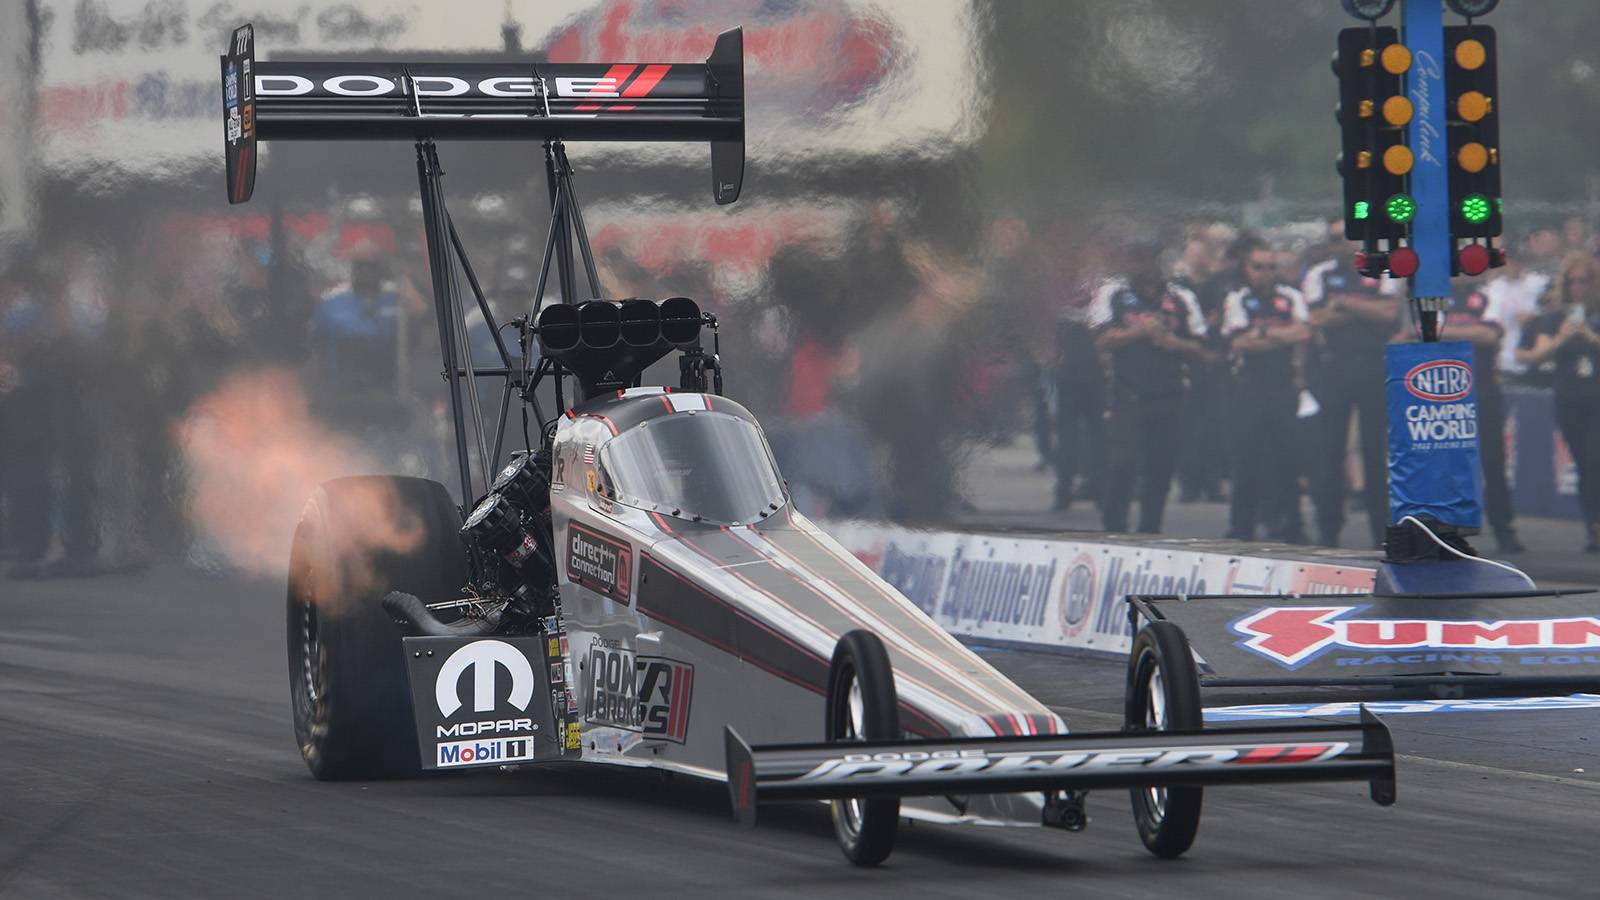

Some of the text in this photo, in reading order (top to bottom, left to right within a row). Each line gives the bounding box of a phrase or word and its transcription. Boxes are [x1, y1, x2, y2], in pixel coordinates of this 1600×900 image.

[255, 75, 619, 98] DODGE
[1416, 367, 1471, 394] NHRA
[1405, 403, 1475, 422] CAMPING
[1408, 420, 1477, 441] WORLD
[571, 555, 615, 585] connection
[1336, 653, 1503, 666] RACING
[437, 718, 533, 738] MOPAR
[441, 742, 501, 764] Mobil
[845, 749, 985, 762] DODGE
[799, 749, 1240, 781] POWER
